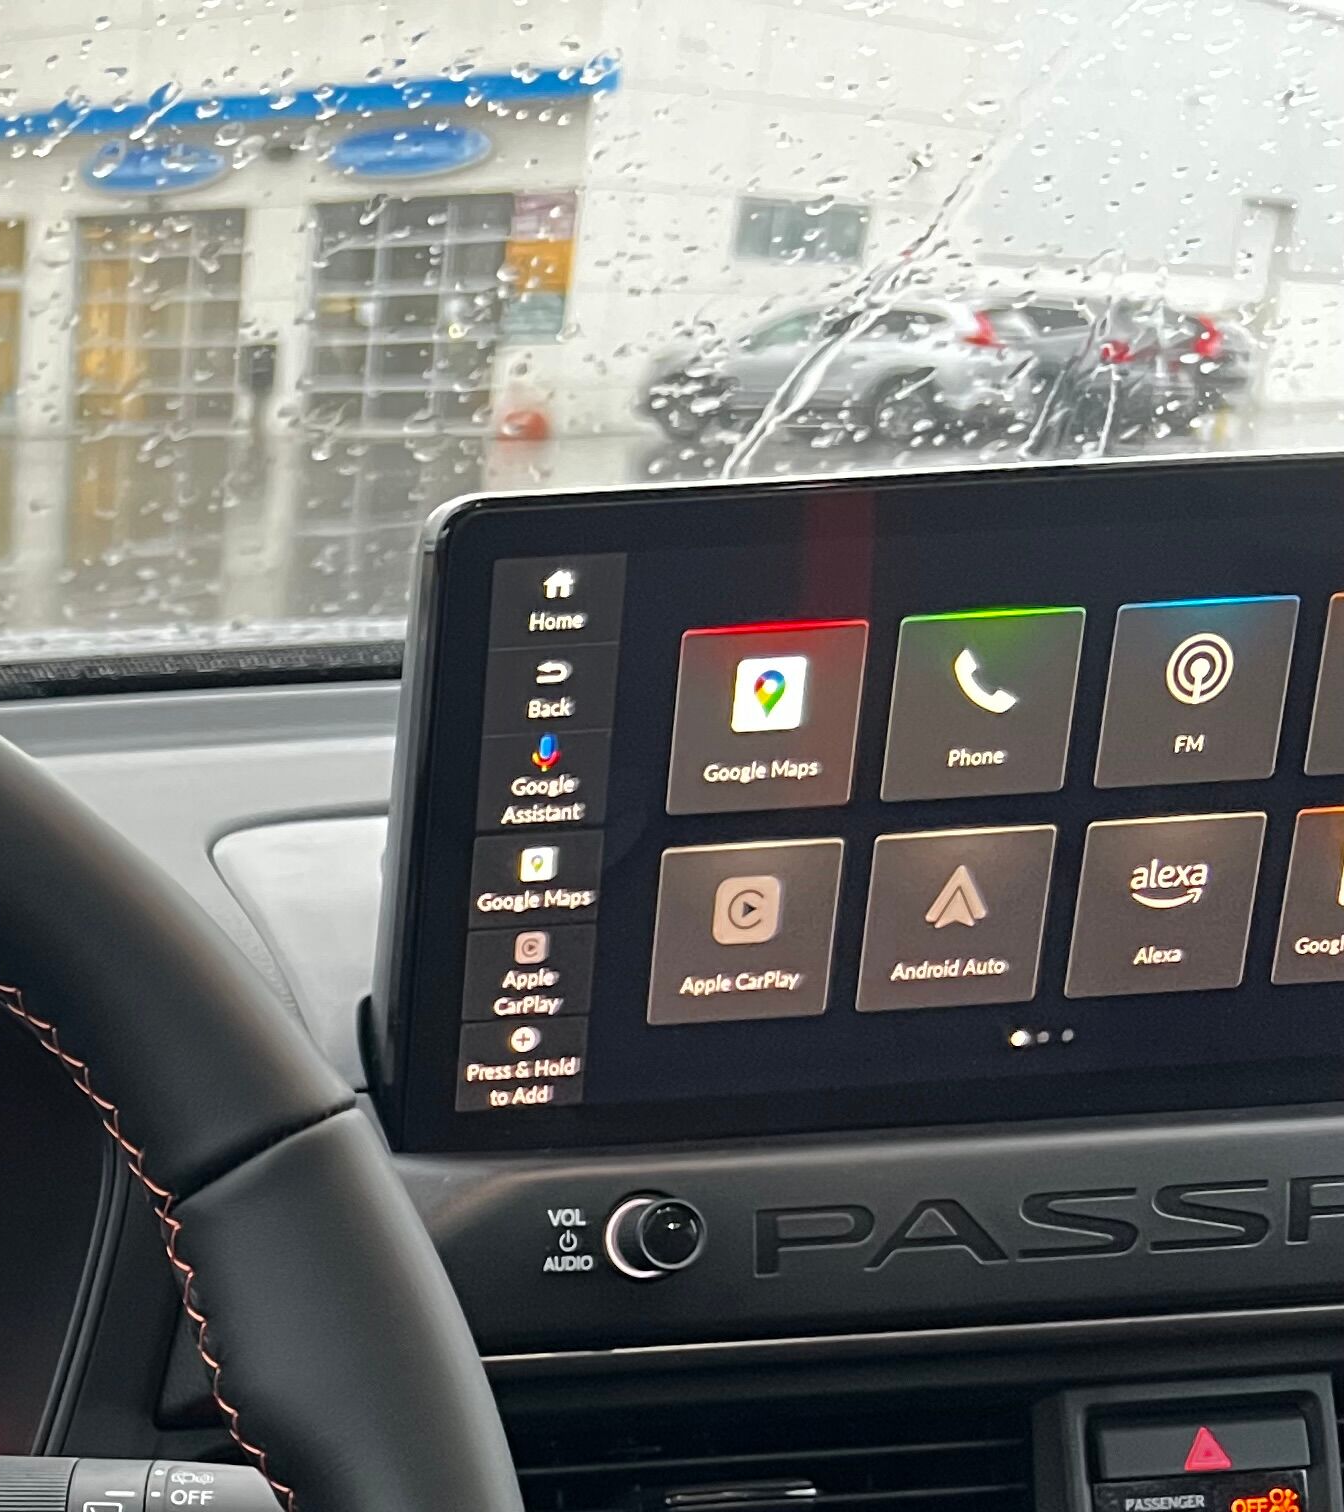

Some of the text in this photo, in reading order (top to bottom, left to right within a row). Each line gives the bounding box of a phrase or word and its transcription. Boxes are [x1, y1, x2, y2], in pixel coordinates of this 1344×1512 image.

[528, 611, 585, 632] Home
[526, 698, 573, 719] Back
[1174, 734, 1205, 754] FM
[946, 748, 1005, 768] Phone
[703, 759, 819, 785] Google Maps
[510, 775, 576, 797] Google
[500, 803, 582, 825] Assistant
[1130, 858, 1209, 891] alexa
[476, 889, 594, 914] Google Maps
[1133, 945, 1182, 966] Alexa
[502, 970, 555, 989] Apple
[890, 957, 1007, 982] Android Auto
[679, 970, 800, 996] Apple CarPlay
[492, 996, 560, 1017] CarPlay
[466, 1056, 577, 1083] Press & Hold
[489, 1085, 550, 1106] to Add
[548, 1209, 586, 1227] VOL
[543, 1254, 594, 1273] AUDIO
[170, 1490, 214, 1505] OFF
[1125, 1495, 1205, 1511] PASSENGER
